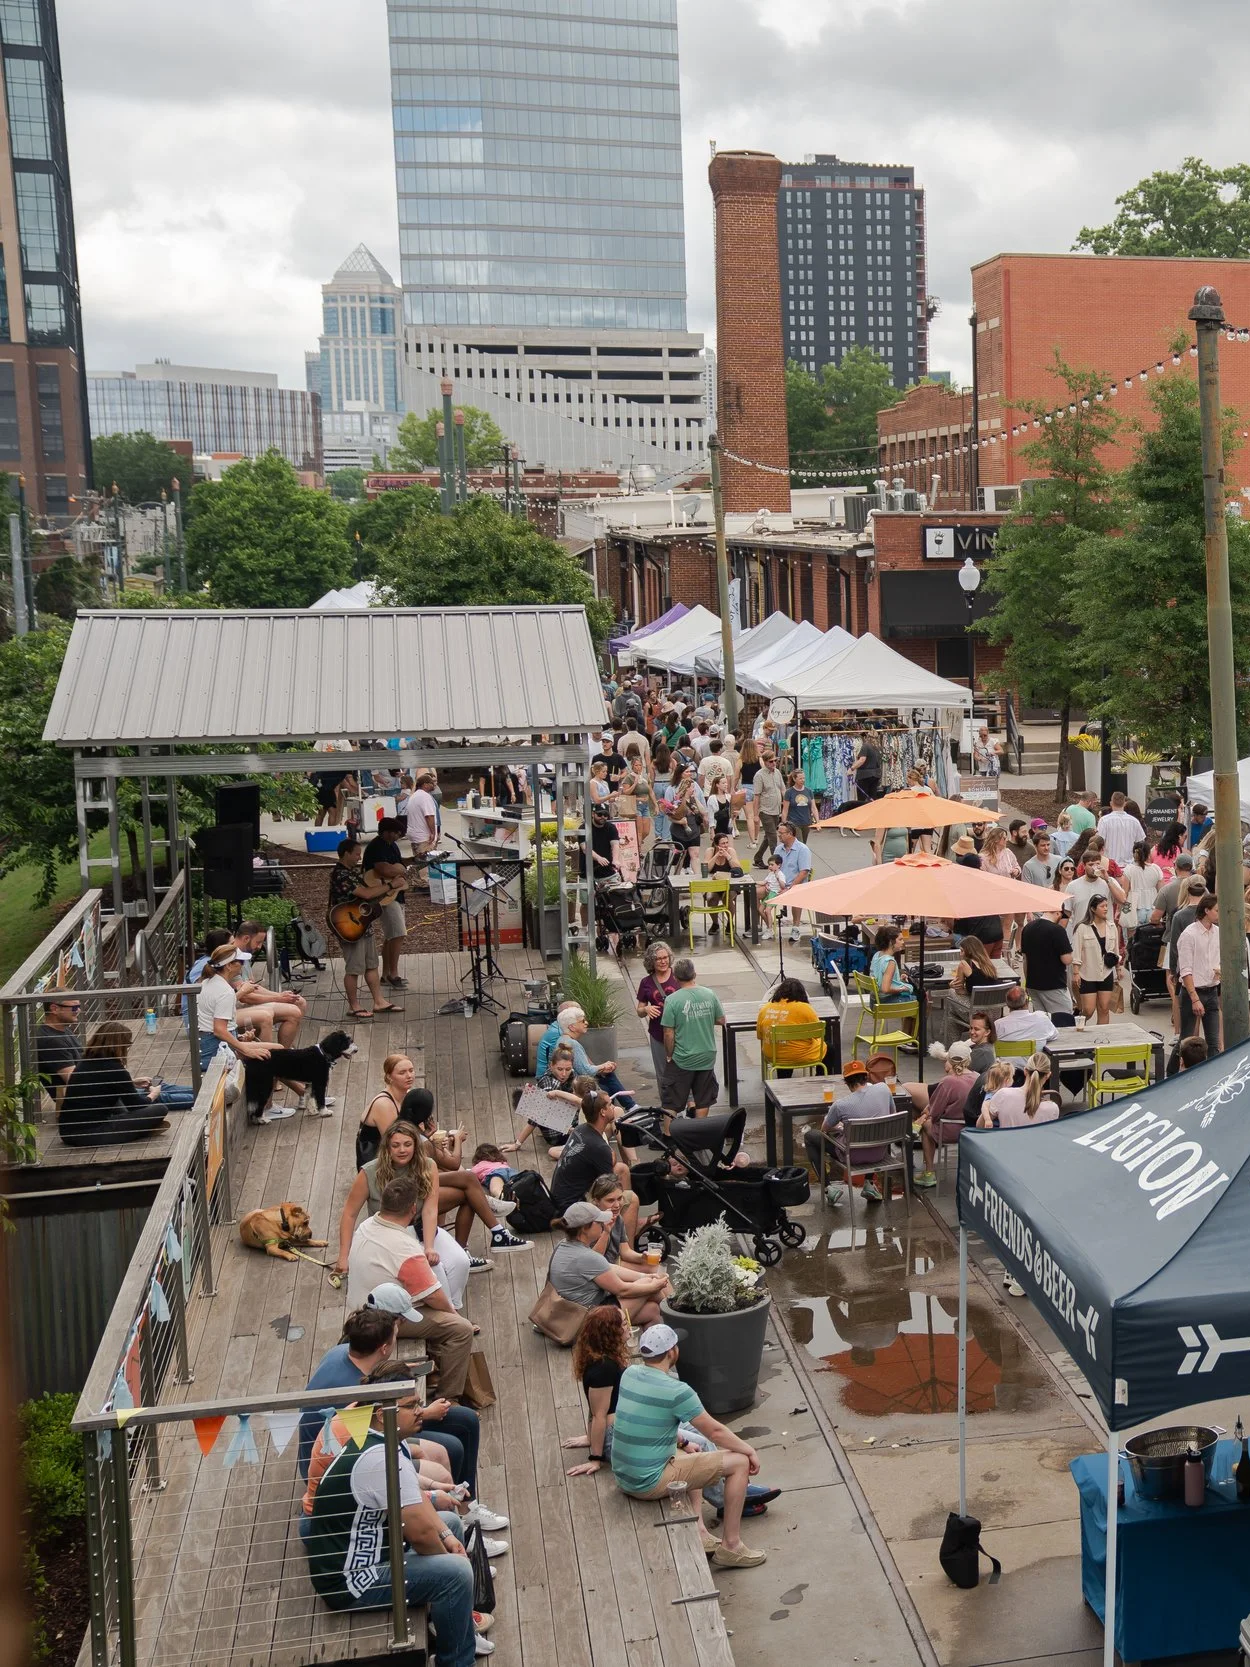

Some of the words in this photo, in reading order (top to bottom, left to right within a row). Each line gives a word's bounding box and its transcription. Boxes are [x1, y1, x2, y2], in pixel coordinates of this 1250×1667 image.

[1072, 1102, 1230, 1222] LEGION
[983, 1182, 1034, 1273] FRIENDS
[1043, 1249, 1077, 1333] BEER
